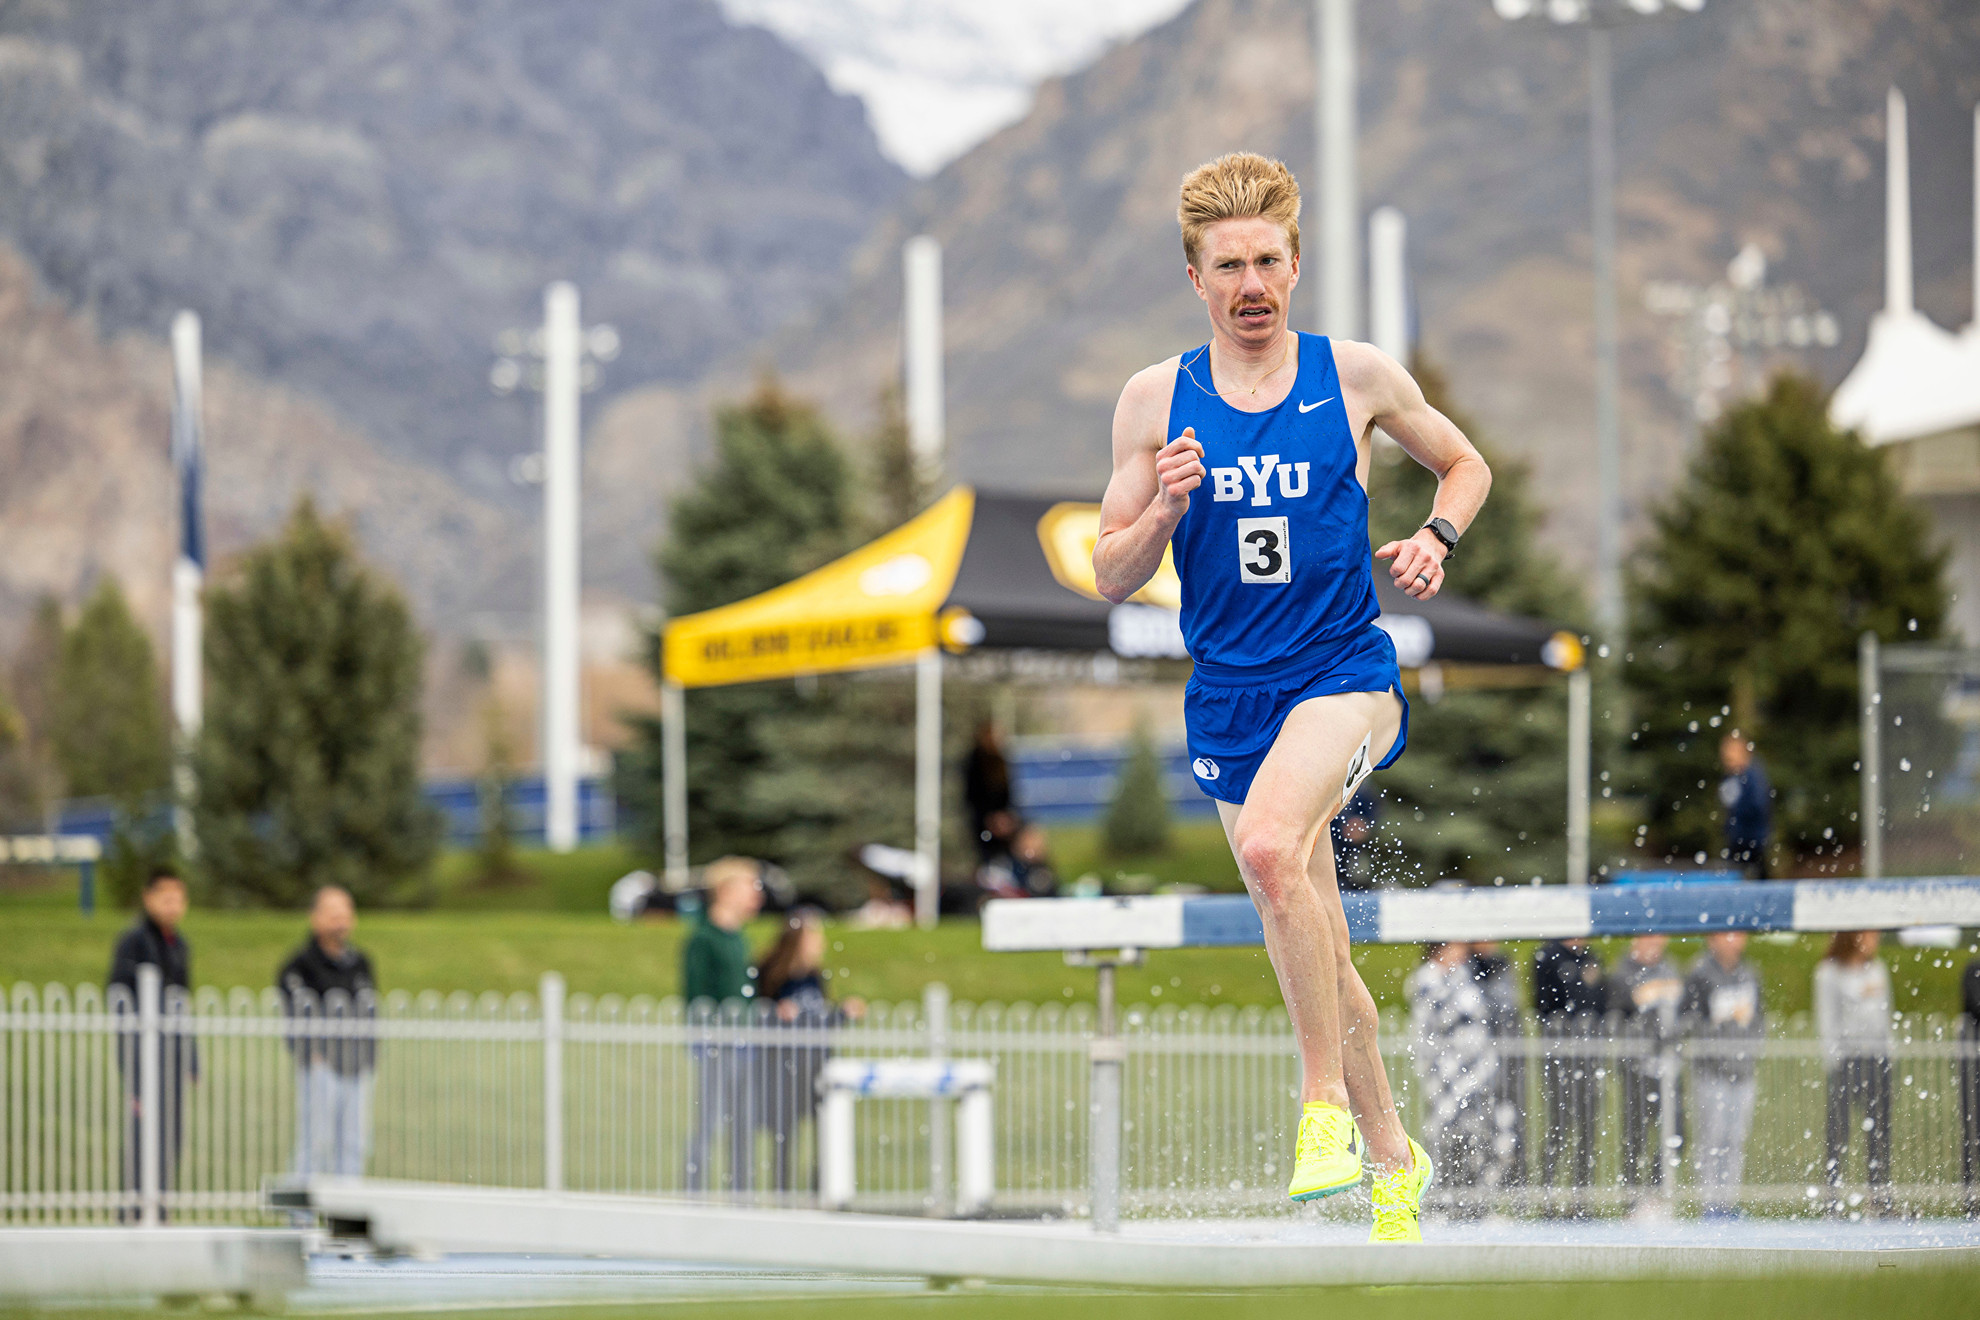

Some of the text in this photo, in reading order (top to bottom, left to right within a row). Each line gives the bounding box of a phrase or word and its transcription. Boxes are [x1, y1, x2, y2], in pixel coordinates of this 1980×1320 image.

[1211, 454, 1310, 507] BYU
[1244, 529, 1283, 577] 3
[1199, 758, 1215, 777] Y
